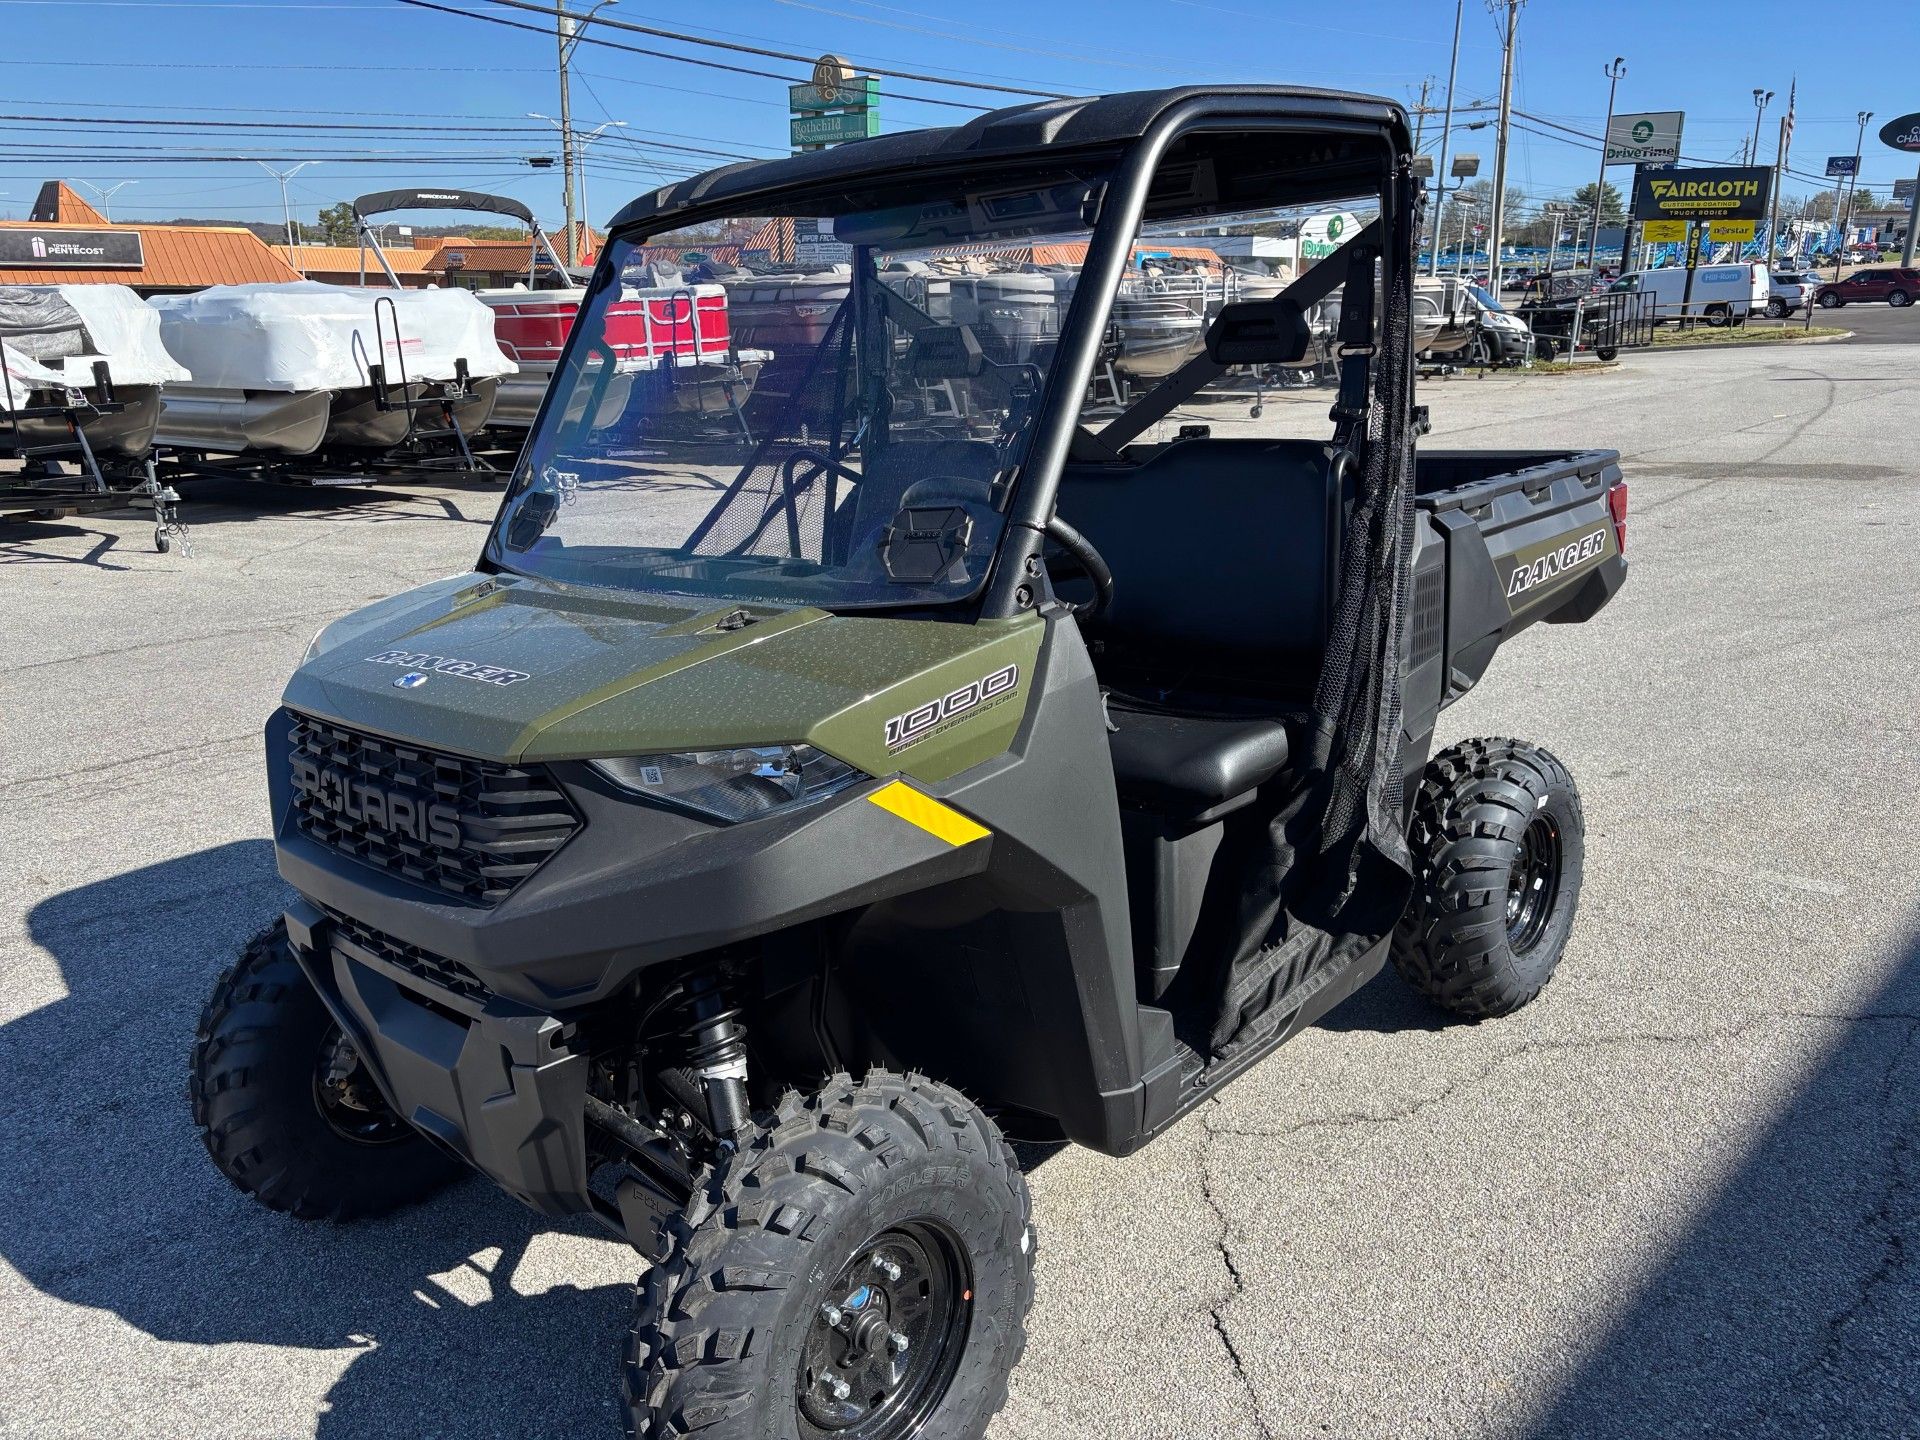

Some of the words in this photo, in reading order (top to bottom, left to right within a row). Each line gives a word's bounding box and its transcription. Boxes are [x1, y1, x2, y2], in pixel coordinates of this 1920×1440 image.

[793, 119, 841, 136] Rothchild
[844, 130, 865, 139] CENTER
[1607, 146, 1675, 159] DriveTime
[1650, 180, 1759, 199] FAIRCLOTH
[48, 247, 104, 255] PENTECOST
[1705, 273, 1738, 281] Hill-Rom
[1507, 528, 1606, 598] RANGER
[364, 650, 531, 686] RANGER
[885, 663, 1020, 746] 1000
[888, 730, 932, 756] SINGLE
[936, 704, 993, 734] OVERHEAD
[995, 690, 1018, 706] CAM
[300, 758, 462, 850] POLARIS
